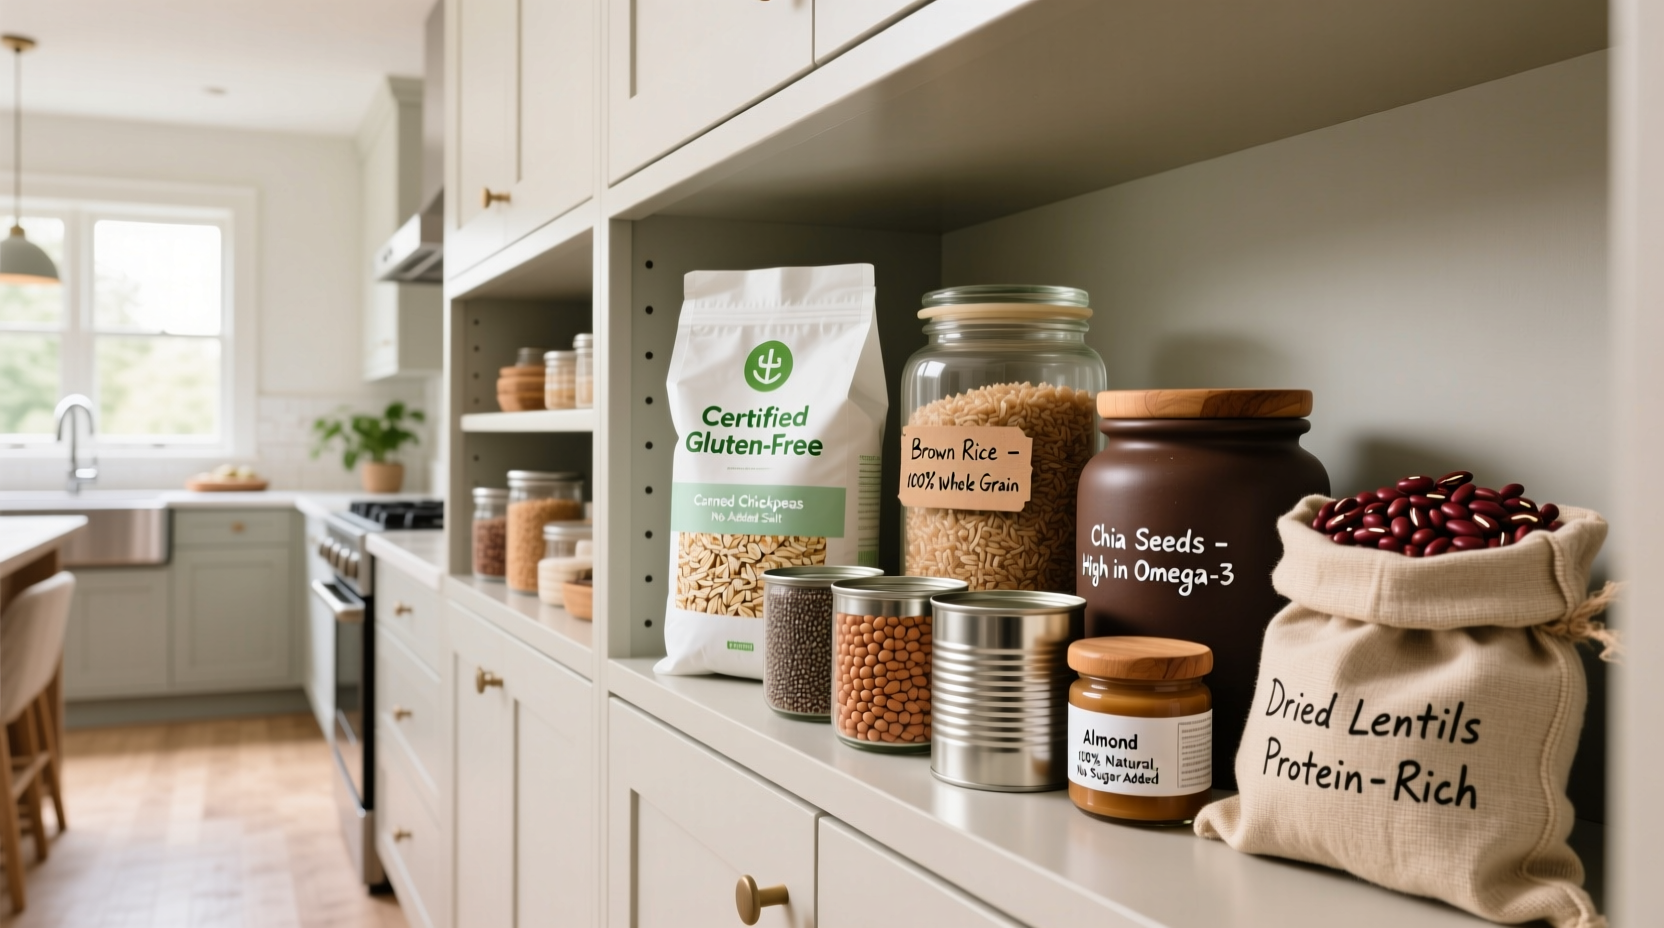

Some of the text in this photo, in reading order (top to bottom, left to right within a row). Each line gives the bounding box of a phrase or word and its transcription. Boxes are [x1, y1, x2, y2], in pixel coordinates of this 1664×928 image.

[701, 404, 810, 429] Certified
[685, 430, 824, 457] Gluten-Free
[911, 437, 955, 460] Brown
[962, 438, 998, 461] Rice
[907, 471, 936, 490] 100%
[980, 472, 1019, 493] Grain
[738, 494, 804, 513] Chickpeas
[711, 511, 725, 523] No
[1091, 523, 1126, 550] Chia
[1135, 527, 1205, 554] Seeds
[1082, 552, 1235, 597] High in Omega-3
[1265, 677, 1481, 744] Dried Lentils
[1083, 728, 1138, 750] Almond
[1122, 772, 1159, 785] Added
